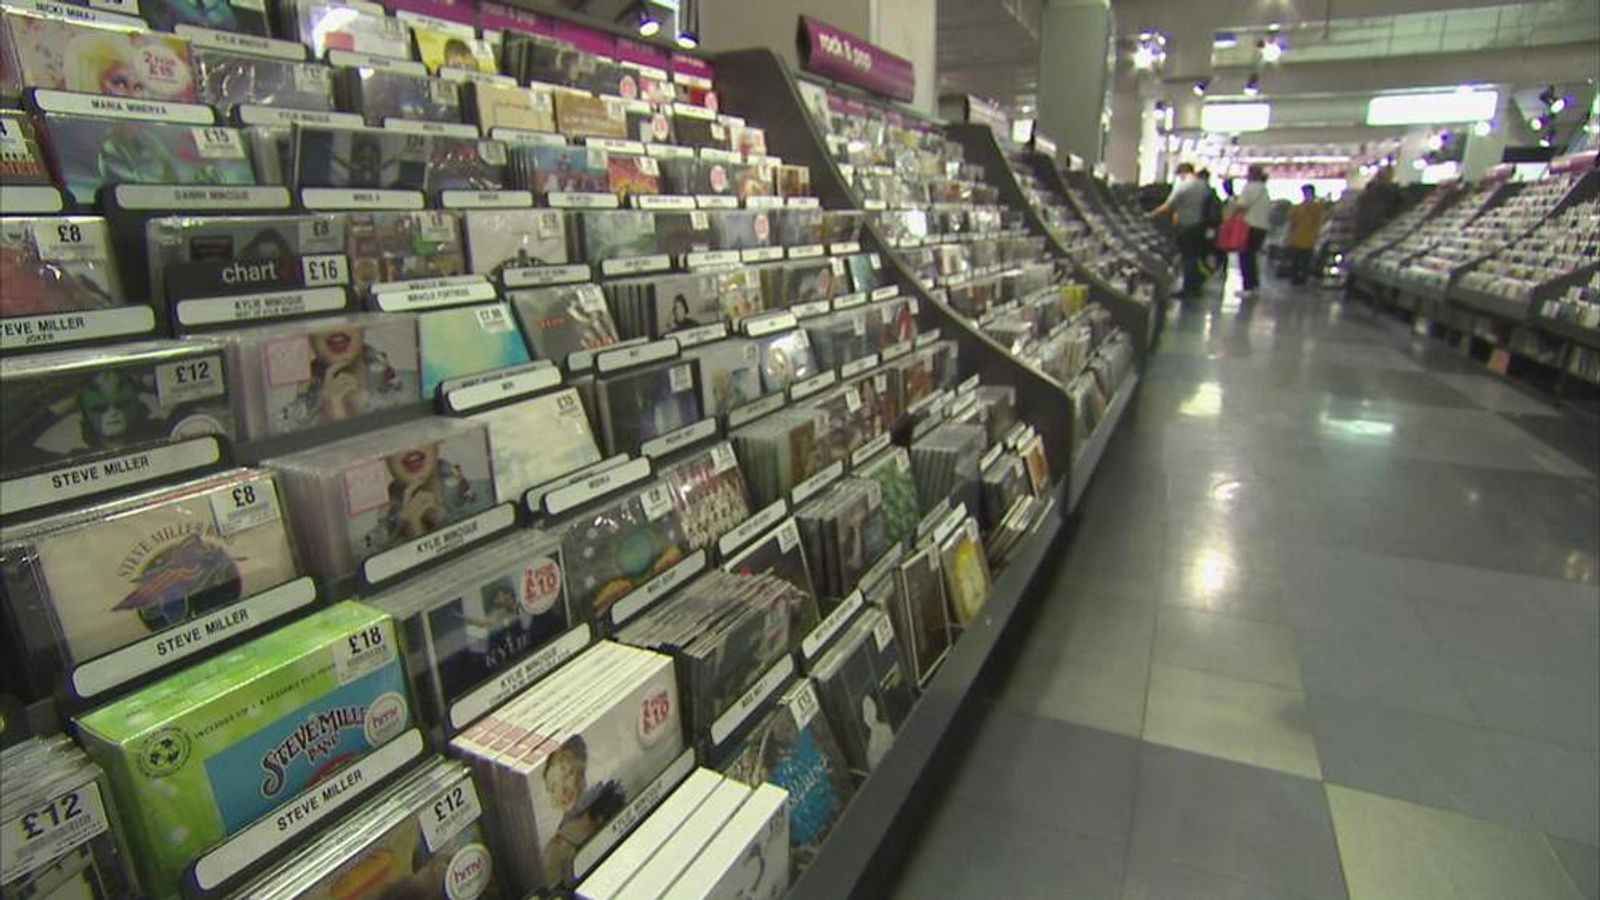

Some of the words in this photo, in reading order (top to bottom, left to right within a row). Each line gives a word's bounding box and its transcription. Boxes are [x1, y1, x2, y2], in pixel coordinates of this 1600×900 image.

[818, 33, 843, 56] rock
[843, 39, 852, 61] &
[852, 47, 872, 72] pop
[90, 99, 122, 111] MARIA
[126, 102, 168, 115] MINERVA
[57, 224, 82, 243] £8
[222, 261, 277, 284] chart
[308, 260, 338, 282] £16
[37, 316, 85, 333] MILLER
[176, 362, 209, 384] £12
[51, 469, 99, 489] STEVE
[103, 455, 150, 477] MILLER
[231, 485, 256, 508] £8
[525, 571, 557, 604] £10
[155, 630, 202, 656] STEVE
[204, 608, 250, 635] MILLER
[348, 626, 382, 655] £18
[260, 720, 316, 797] STEVE
[309, 705, 370, 745] MILLE
[276, 802, 315, 831] STEVE
[317, 769, 363, 804] MILLER
[434, 786, 465, 821] £12
[21, 793, 82, 840] £12
[453, 857, 482, 884] hmv
